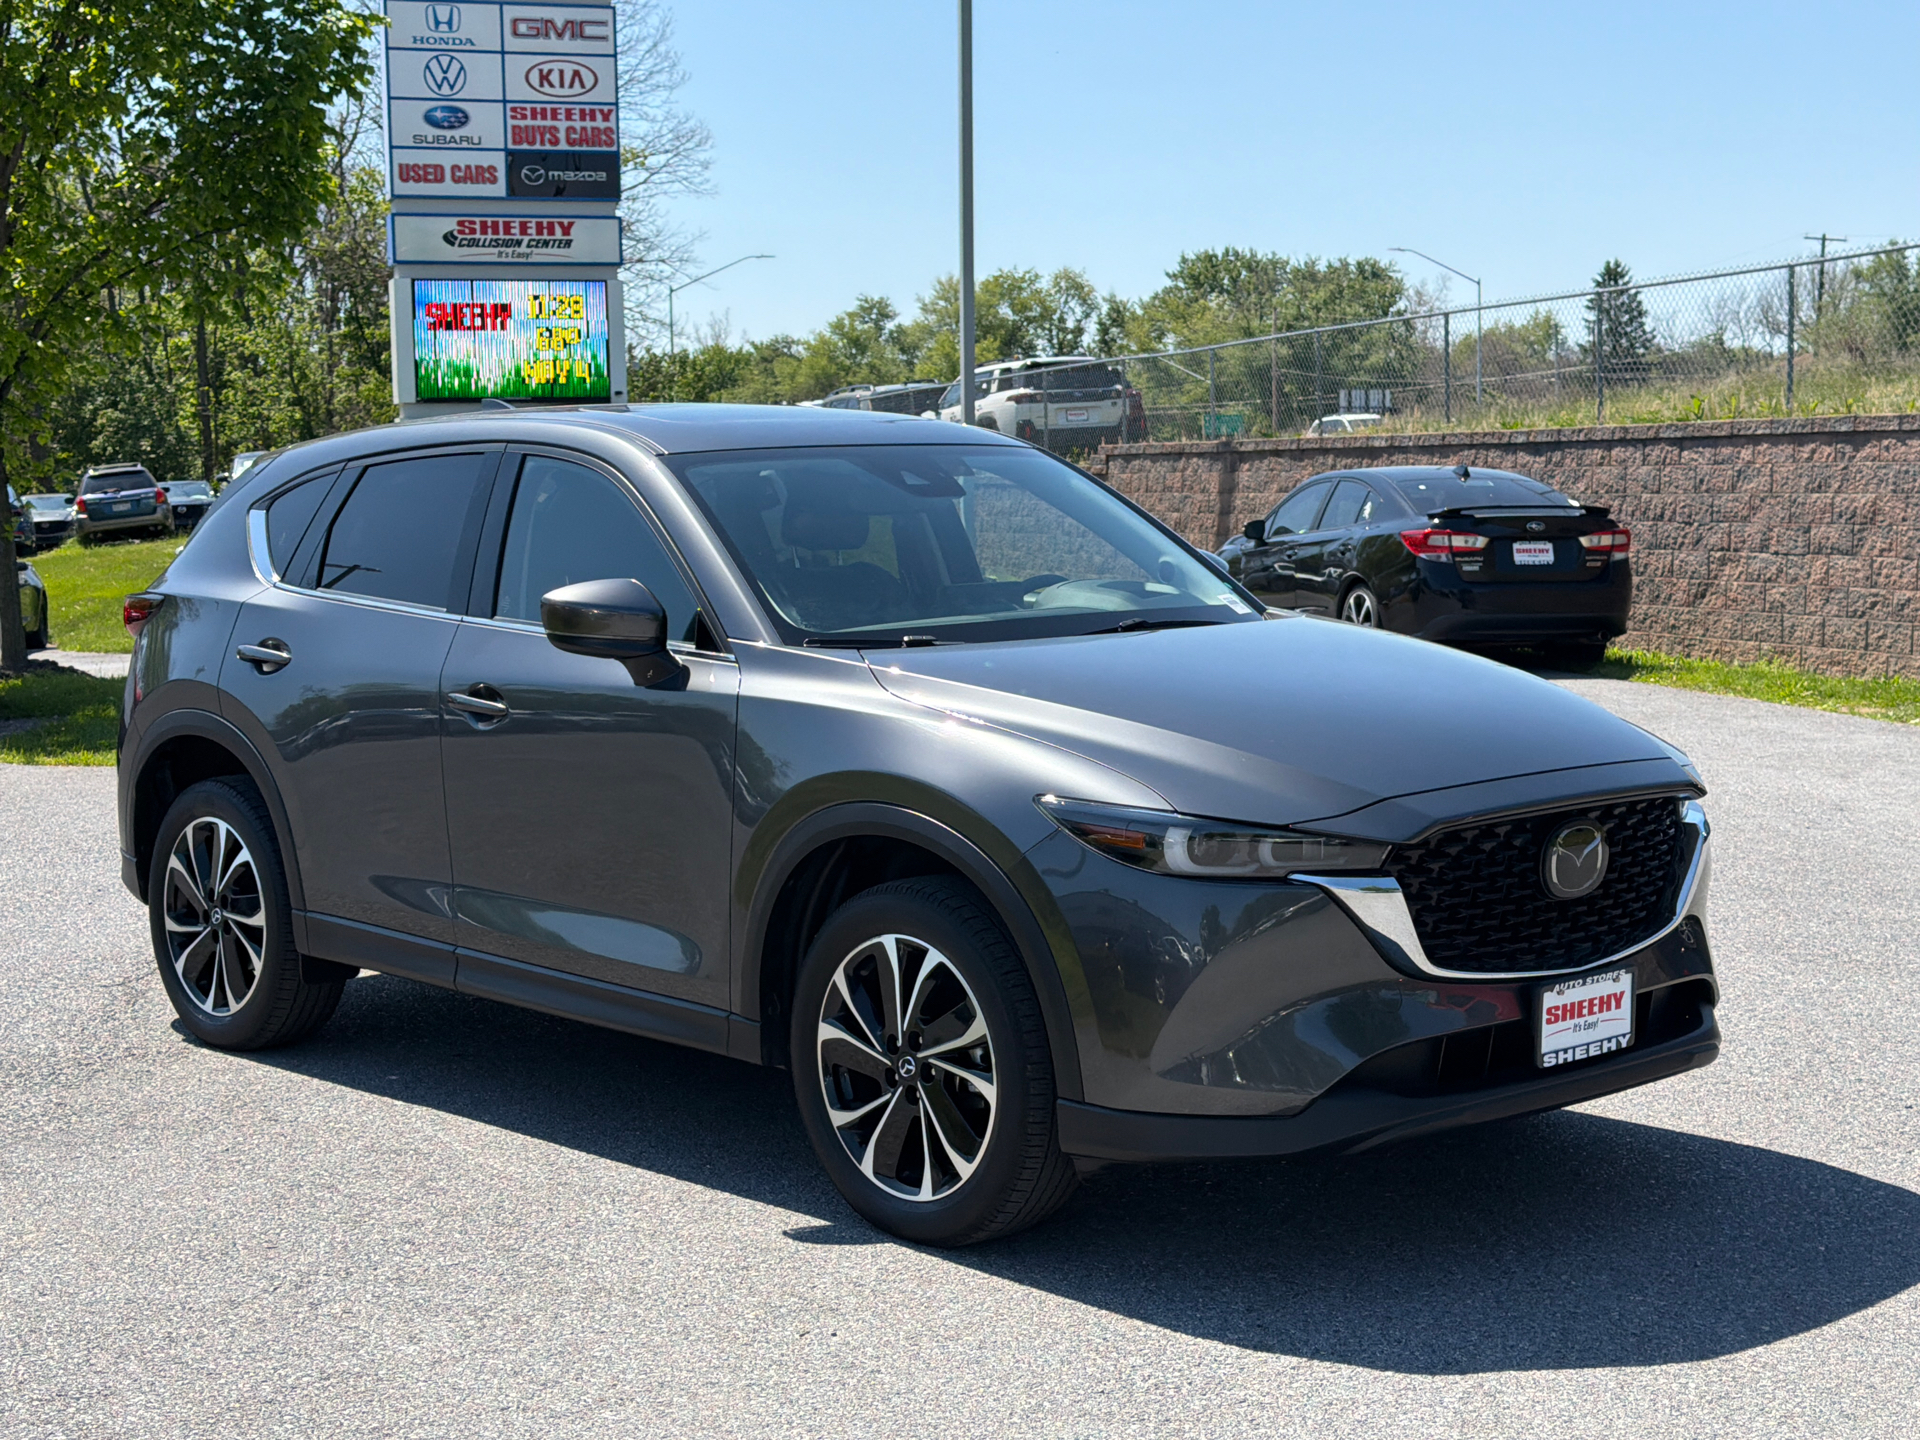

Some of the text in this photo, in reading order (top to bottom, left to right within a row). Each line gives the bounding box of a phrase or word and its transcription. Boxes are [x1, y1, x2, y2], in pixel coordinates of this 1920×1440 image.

[511, 17, 609, 41] GMC
[412, 36, 476, 46] HONDA
[538, 68, 587, 89] KIA
[510, 106, 614, 122] SHEEHY
[412, 134, 482, 146] SUBARU
[511, 125, 615, 148] BUYS CARS
[398, 163, 498, 184] USED CARS
[548, 170, 607, 182] mazda
[456, 220, 576, 236] SHEEHY
[457, 238, 574, 249] COLLISION CENTER
[511, 250, 534, 260] Easy!
[1553, 979, 1583, 993] AUTO
[1546, 990, 1625, 1025] SHEEHY
[1572, 1018, 1600, 1033] It's Easy!
[1543, 1034, 1631, 1068] SHEEHY
